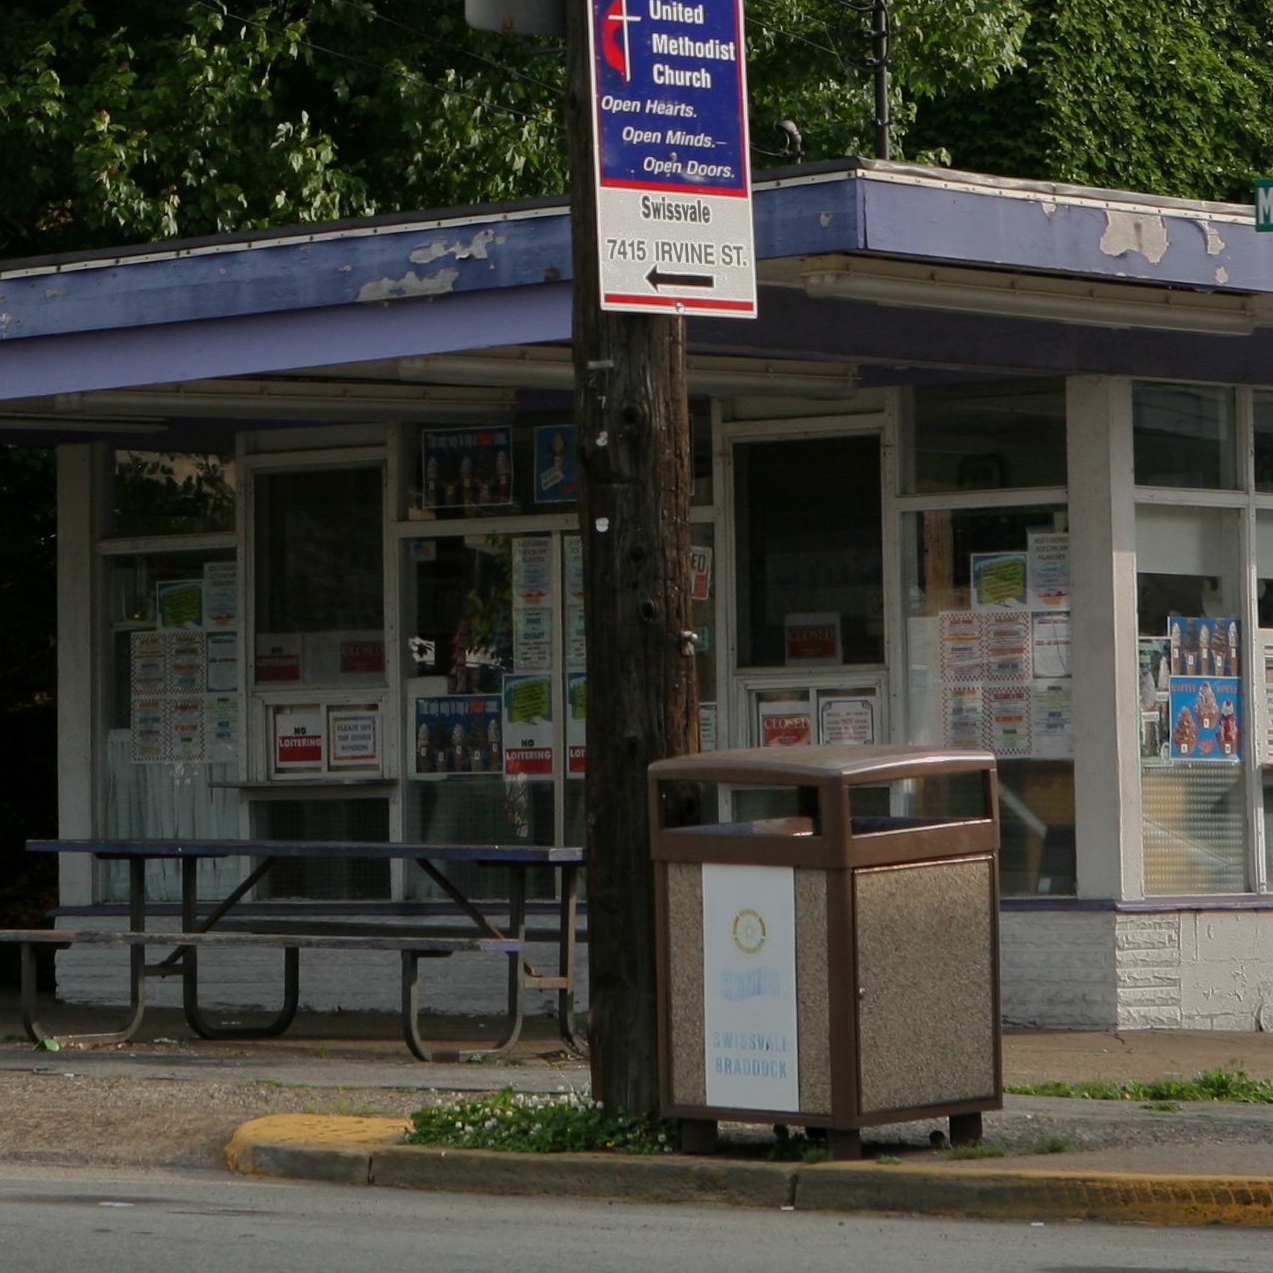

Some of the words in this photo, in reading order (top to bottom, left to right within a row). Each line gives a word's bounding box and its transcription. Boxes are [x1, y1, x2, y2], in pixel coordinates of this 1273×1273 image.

[652, 33, 736, 62] Methodist
[652, 63, 712, 89] Church
[601, 94, 641, 115] Open
[645, 98, 698, 118] Hearts.
[621, 126, 662, 147] Open
[665, 129, 717, 148] Minds.
[643, 156, 683, 178] Open
[687, 159, 735, 179] Doors.
[641, 194, 711, 225] Swissvale
[606, 238, 647, 261] 7415
[655, 241, 715, 266] IRVINE
[721, 244, 748, 268] ST.
[271, 646, 284, 655] NO
[294, 727, 306, 735] NO
[763, 716, 810, 730] CLOSED
[279, 738, 321, 748] LOITERING
[521, 738, 535, 747] NO
[506, 750, 552, 760] LOITERING
[715, 1055, 788, 1079] BRADDOCK
